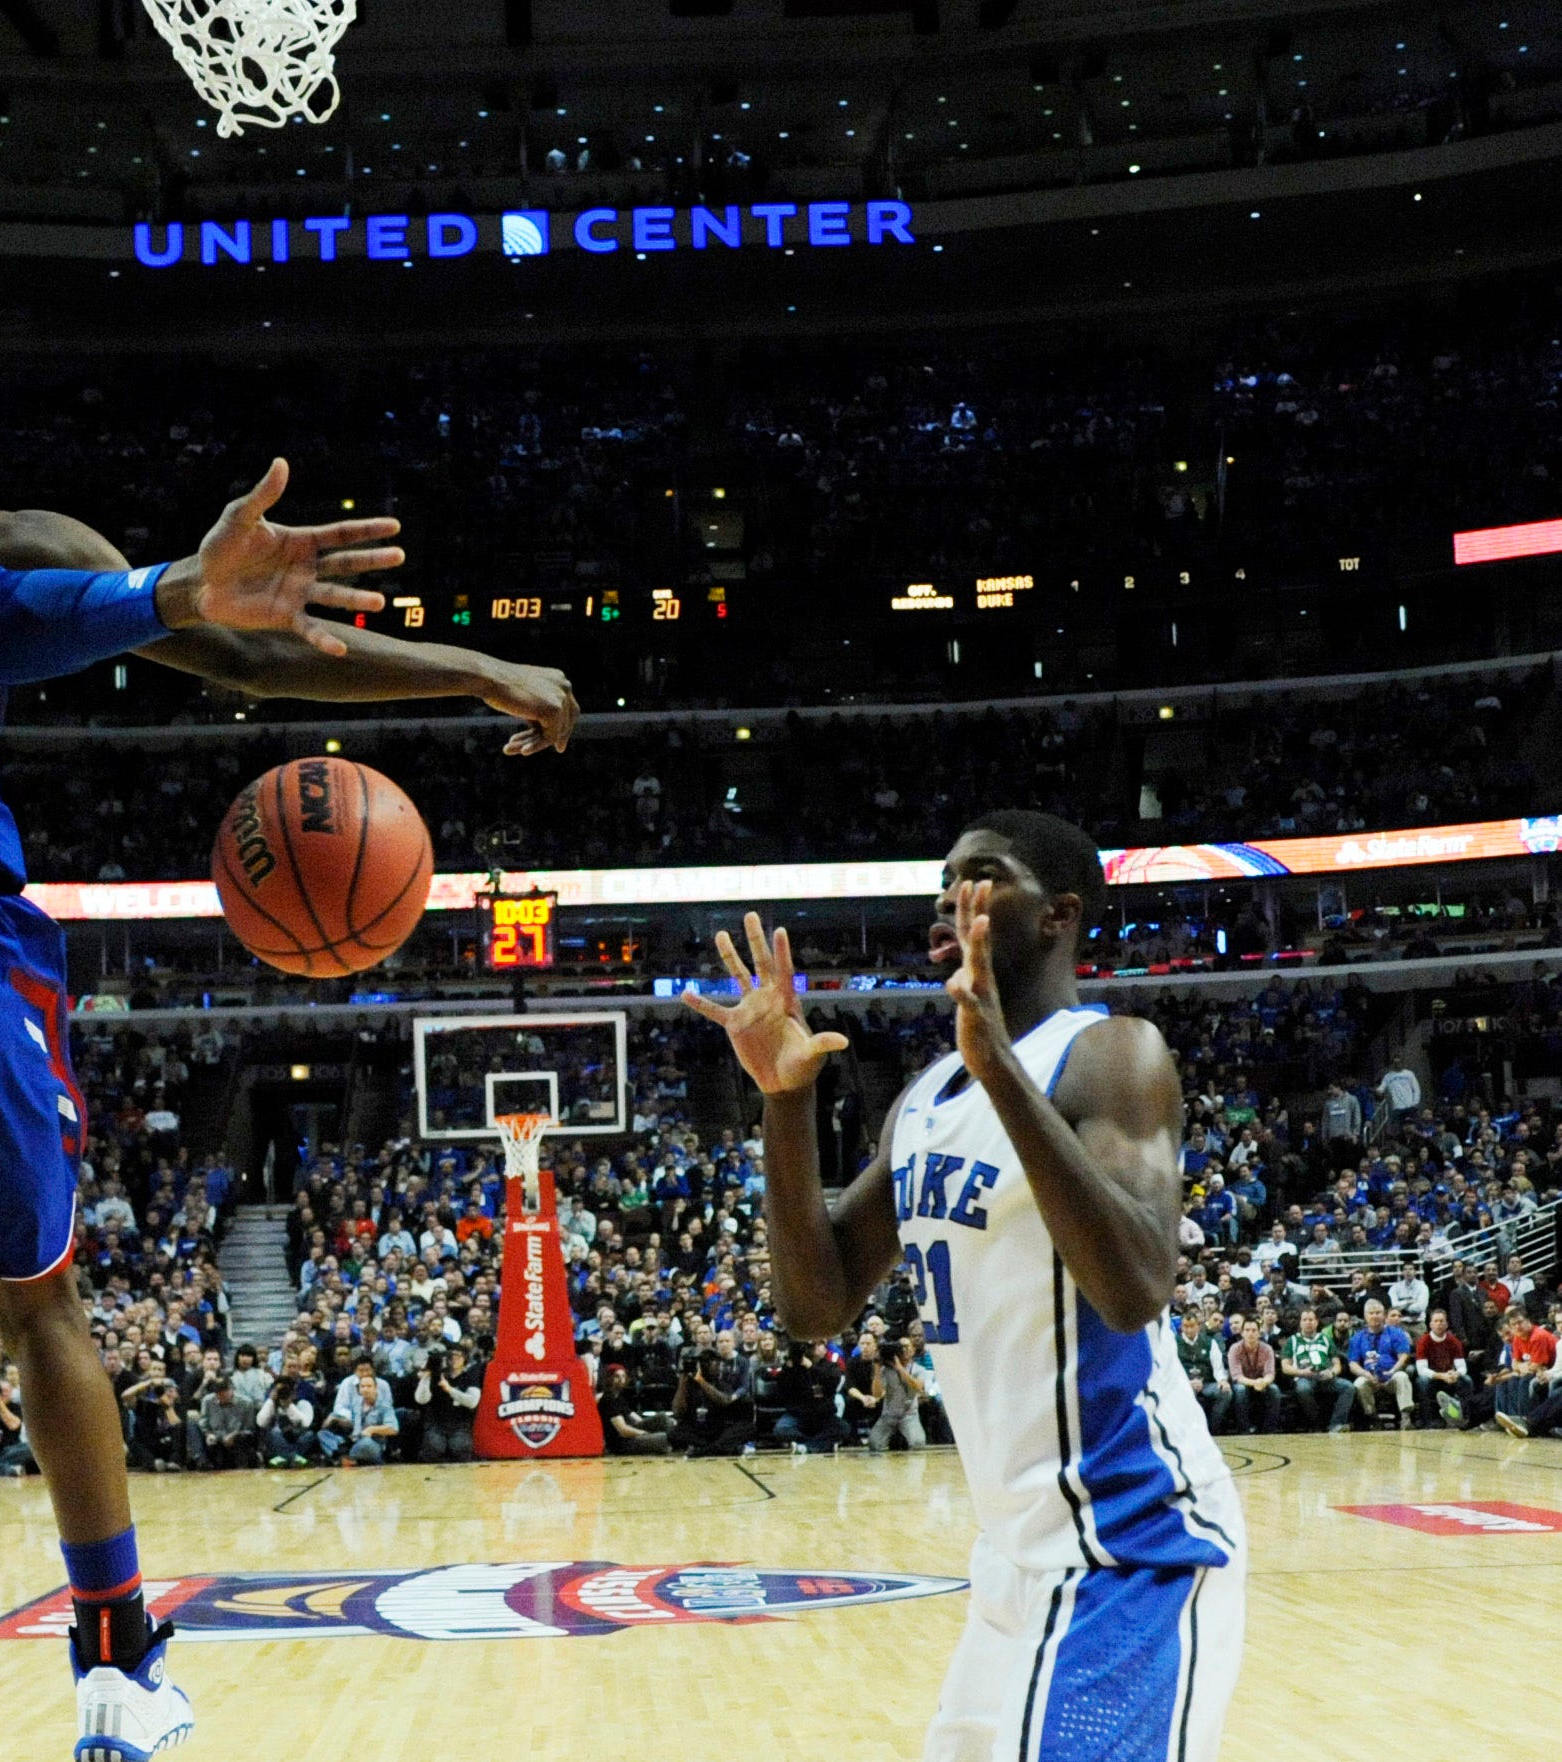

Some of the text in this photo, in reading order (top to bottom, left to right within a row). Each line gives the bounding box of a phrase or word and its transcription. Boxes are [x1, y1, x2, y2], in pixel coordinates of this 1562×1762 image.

[134, 200, 916, 267] UNITED CENTER
[976, 575, 1034, 593] KANSAS
[1124, 577, 1135, 589] 2
[1179, 572, 1190, 585] 3
[491, 597, 542, 619] 10:03
[653, 599, 680, 620] 20
[977, 592, 1014, 609] DUKE
[404, 606, 425, 628] 19
[494, 900, 548, 925] 10:03
[492, 924, 545, 963] 27
